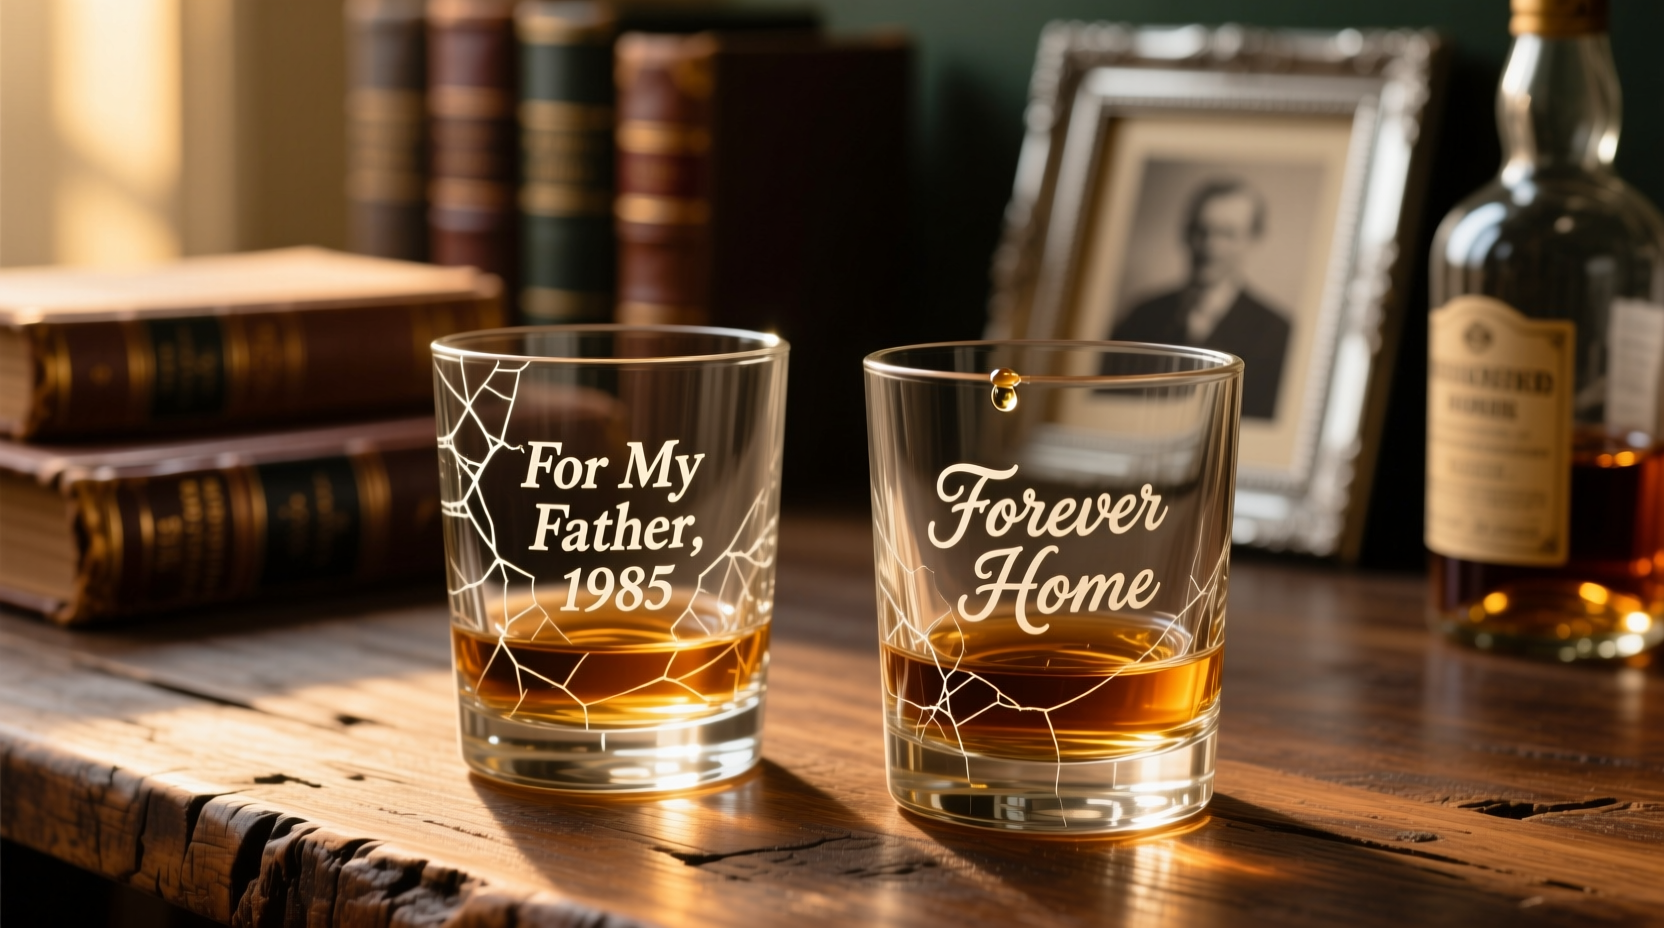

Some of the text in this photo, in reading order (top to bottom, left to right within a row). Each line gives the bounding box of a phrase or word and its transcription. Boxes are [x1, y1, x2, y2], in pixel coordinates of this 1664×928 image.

[520, 439, 705, 502] For My
[528, 501, 703, 557] Father,
[928, 463, 1168, 549] Forever
[560, 564, 676, 612] 1985
[957, 545, 1160, 635] Home
